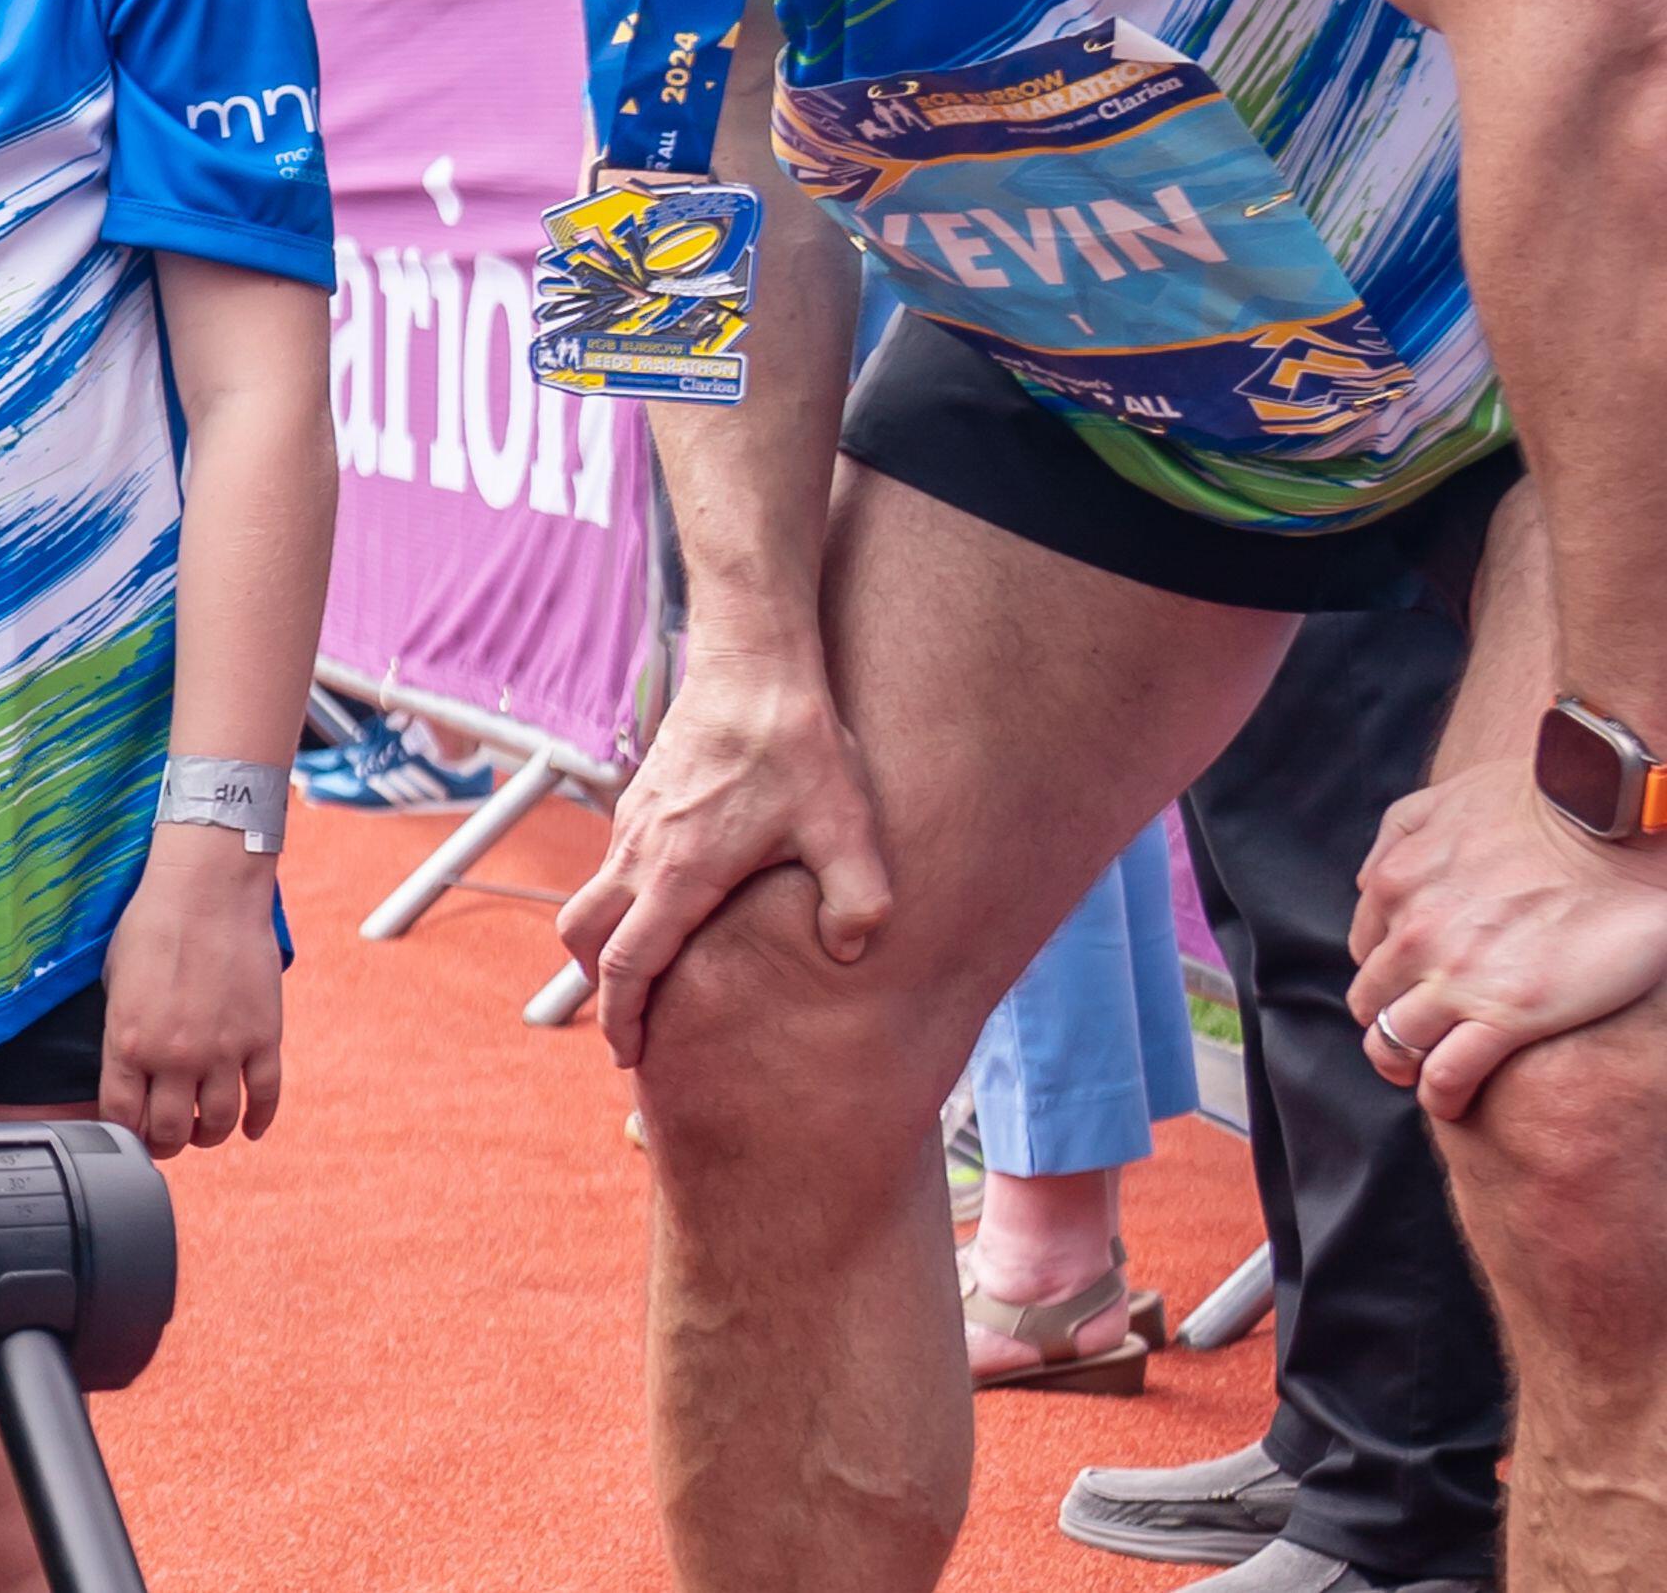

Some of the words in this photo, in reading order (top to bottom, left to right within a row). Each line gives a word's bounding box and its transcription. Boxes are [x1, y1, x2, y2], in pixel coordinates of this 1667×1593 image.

[661, 32, 701, 105] 2024
[186, 84, 318, 144] mn
[1099, 75, 1184, 121] Clarion
[658, 130, 679, 160] ALL
[330, 155, 613, 528] arion
[585, 354, 633, 371] LEEDS
[637, 357, 739, 377] MARATHON
[678, 377, 737, 395] Clarion
[1123, 395, 1184, 419] ALL
